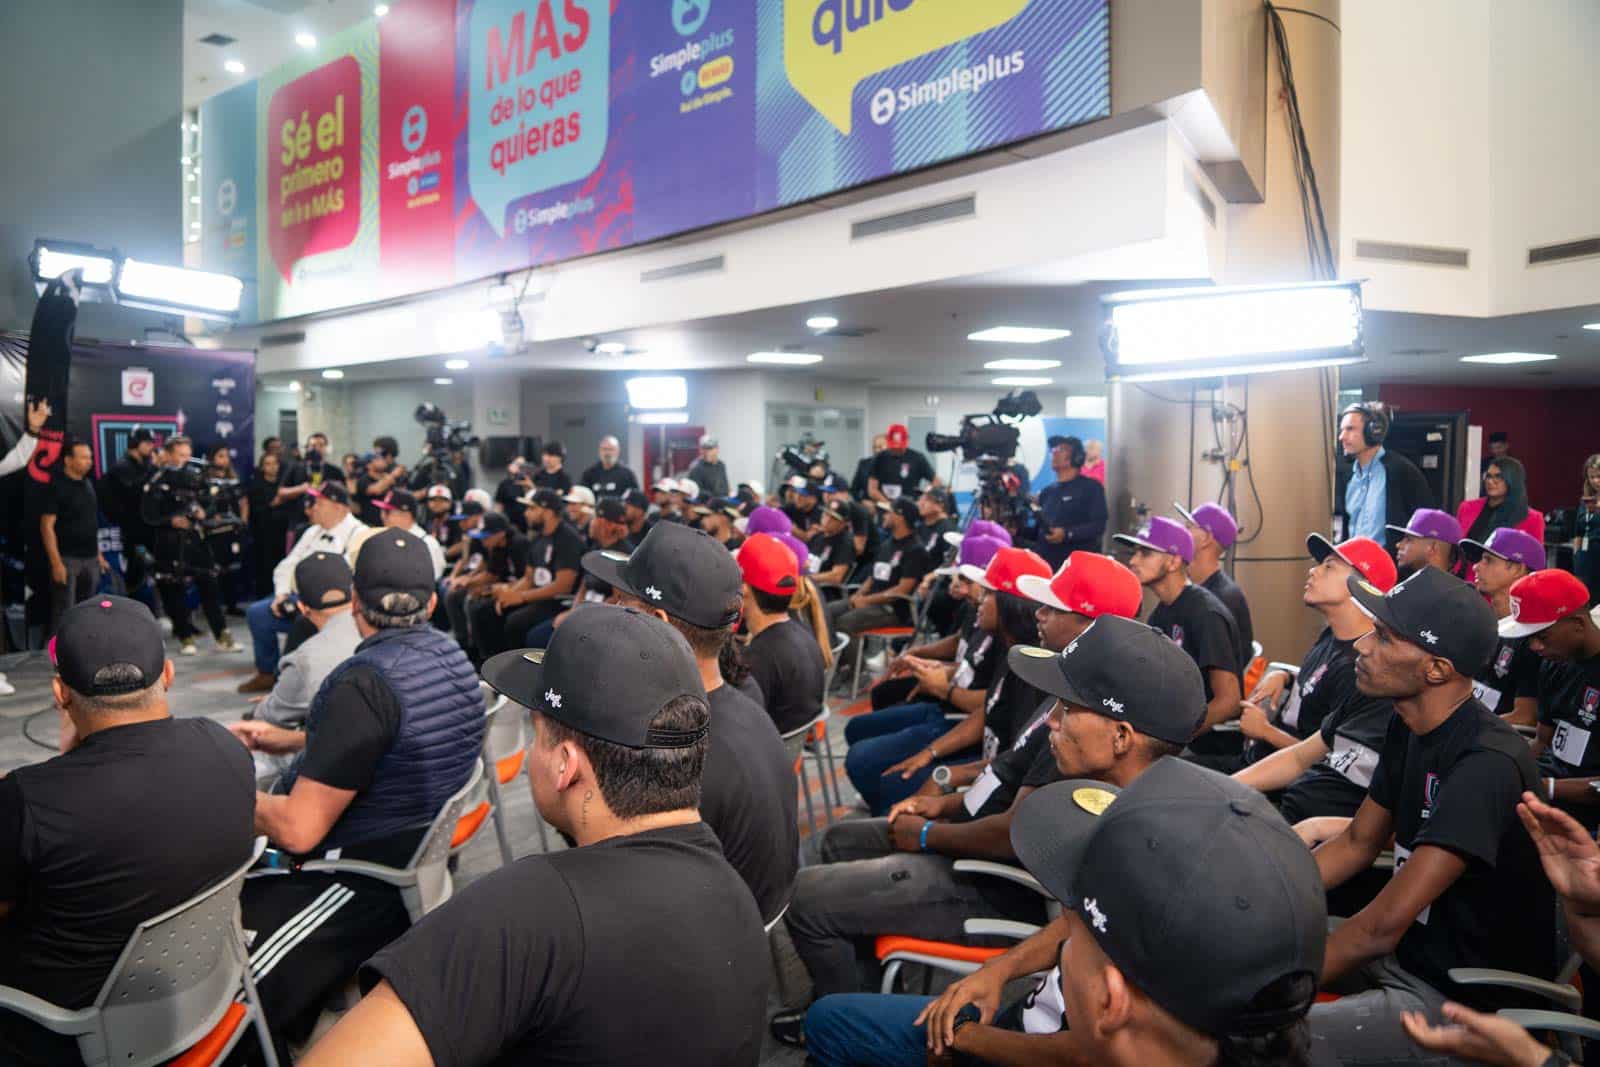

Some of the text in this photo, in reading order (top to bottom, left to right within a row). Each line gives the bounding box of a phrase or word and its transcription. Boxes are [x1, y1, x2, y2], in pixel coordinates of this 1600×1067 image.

[650, 28, 734, 77] Simpleplus
[897, 50, 1024, 112] Simpleplus
[489, 69, 581, 126] de lo que
[281, 94, 344, 166] Sé el
[490, 112, 581, 176] quieras
